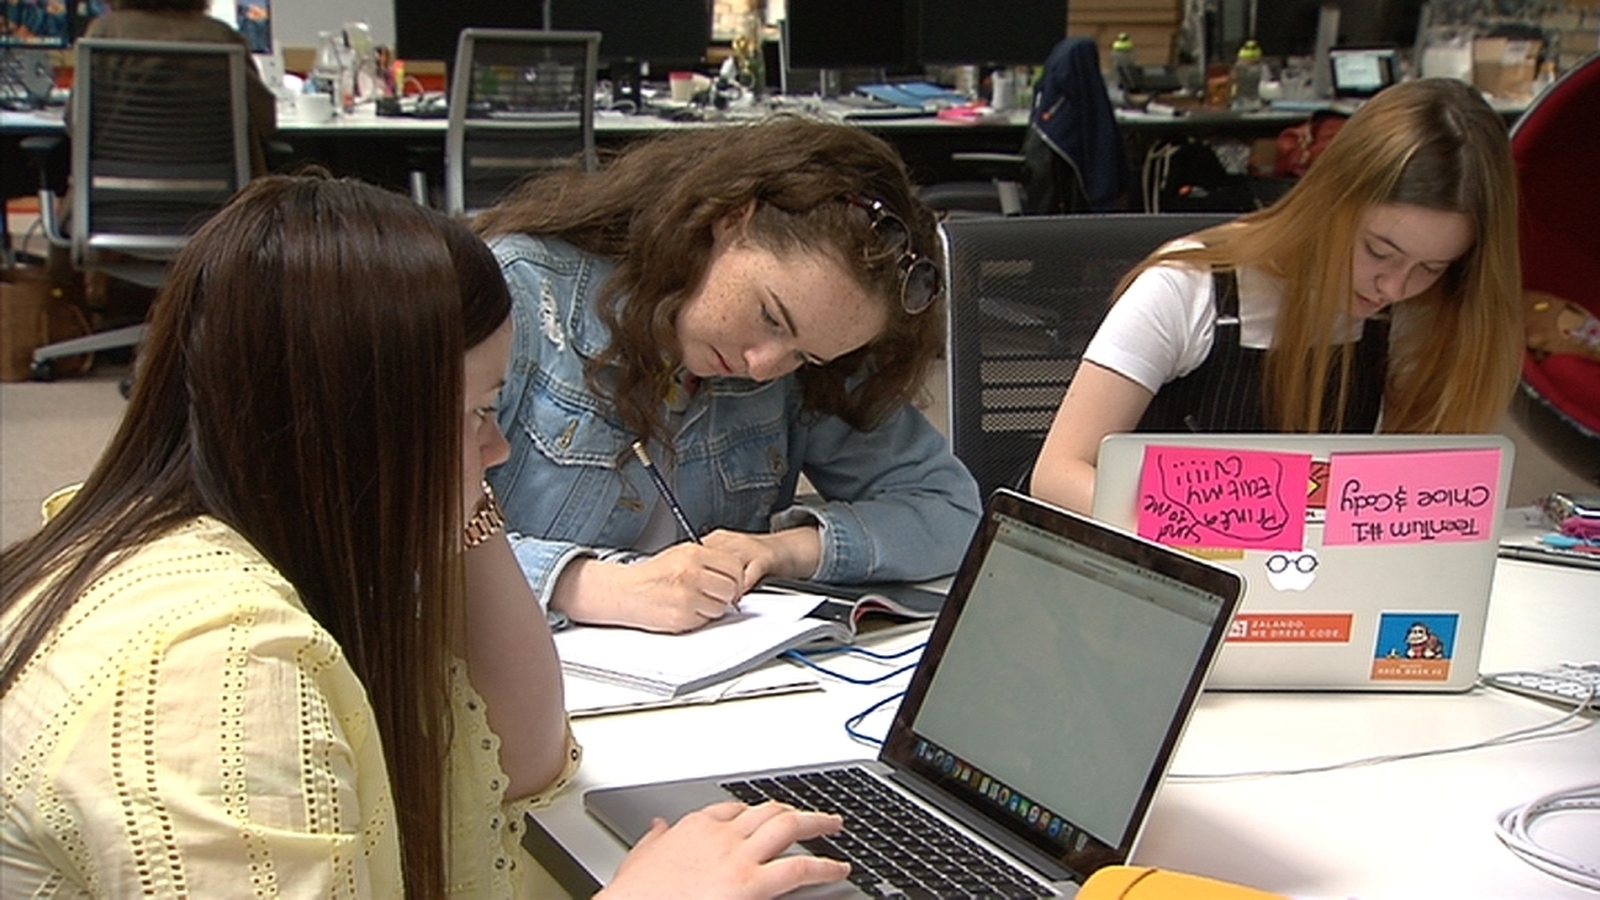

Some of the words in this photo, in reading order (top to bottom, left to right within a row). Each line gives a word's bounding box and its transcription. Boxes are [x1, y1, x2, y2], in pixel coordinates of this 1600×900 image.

[1228, 476, 1272, 500] Edit
[1340, 479, 1393, 516] Cody
[1416, 485, 1490, 508] Chloe
[1351, 522, 1384, 542] #1
